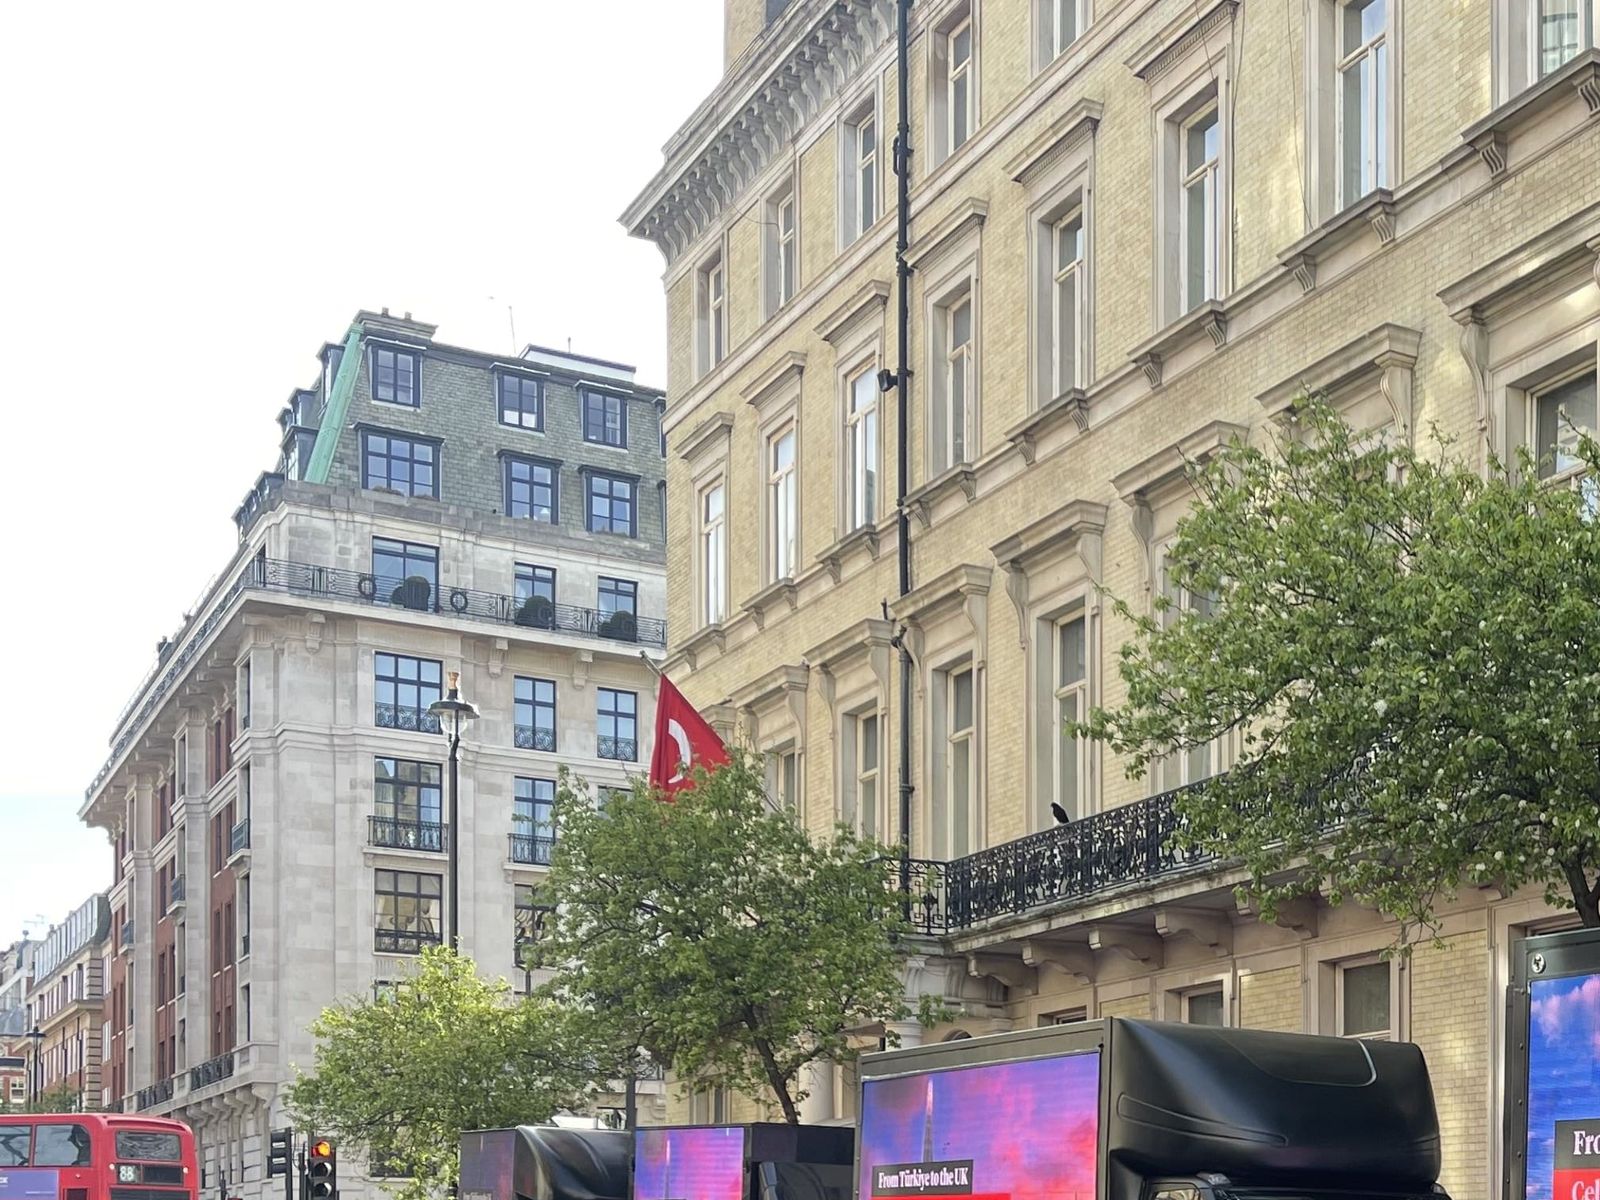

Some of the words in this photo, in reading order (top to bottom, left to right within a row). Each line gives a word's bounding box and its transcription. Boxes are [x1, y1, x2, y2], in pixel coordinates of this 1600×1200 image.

[119, 1165, 135, 1182] 88
[878, 1172, 899, 1189] From
[930, 1170, 940, 1187] to
[940, 1167, 954, 1186] the
[954, 1167, 969, 1185] UK
